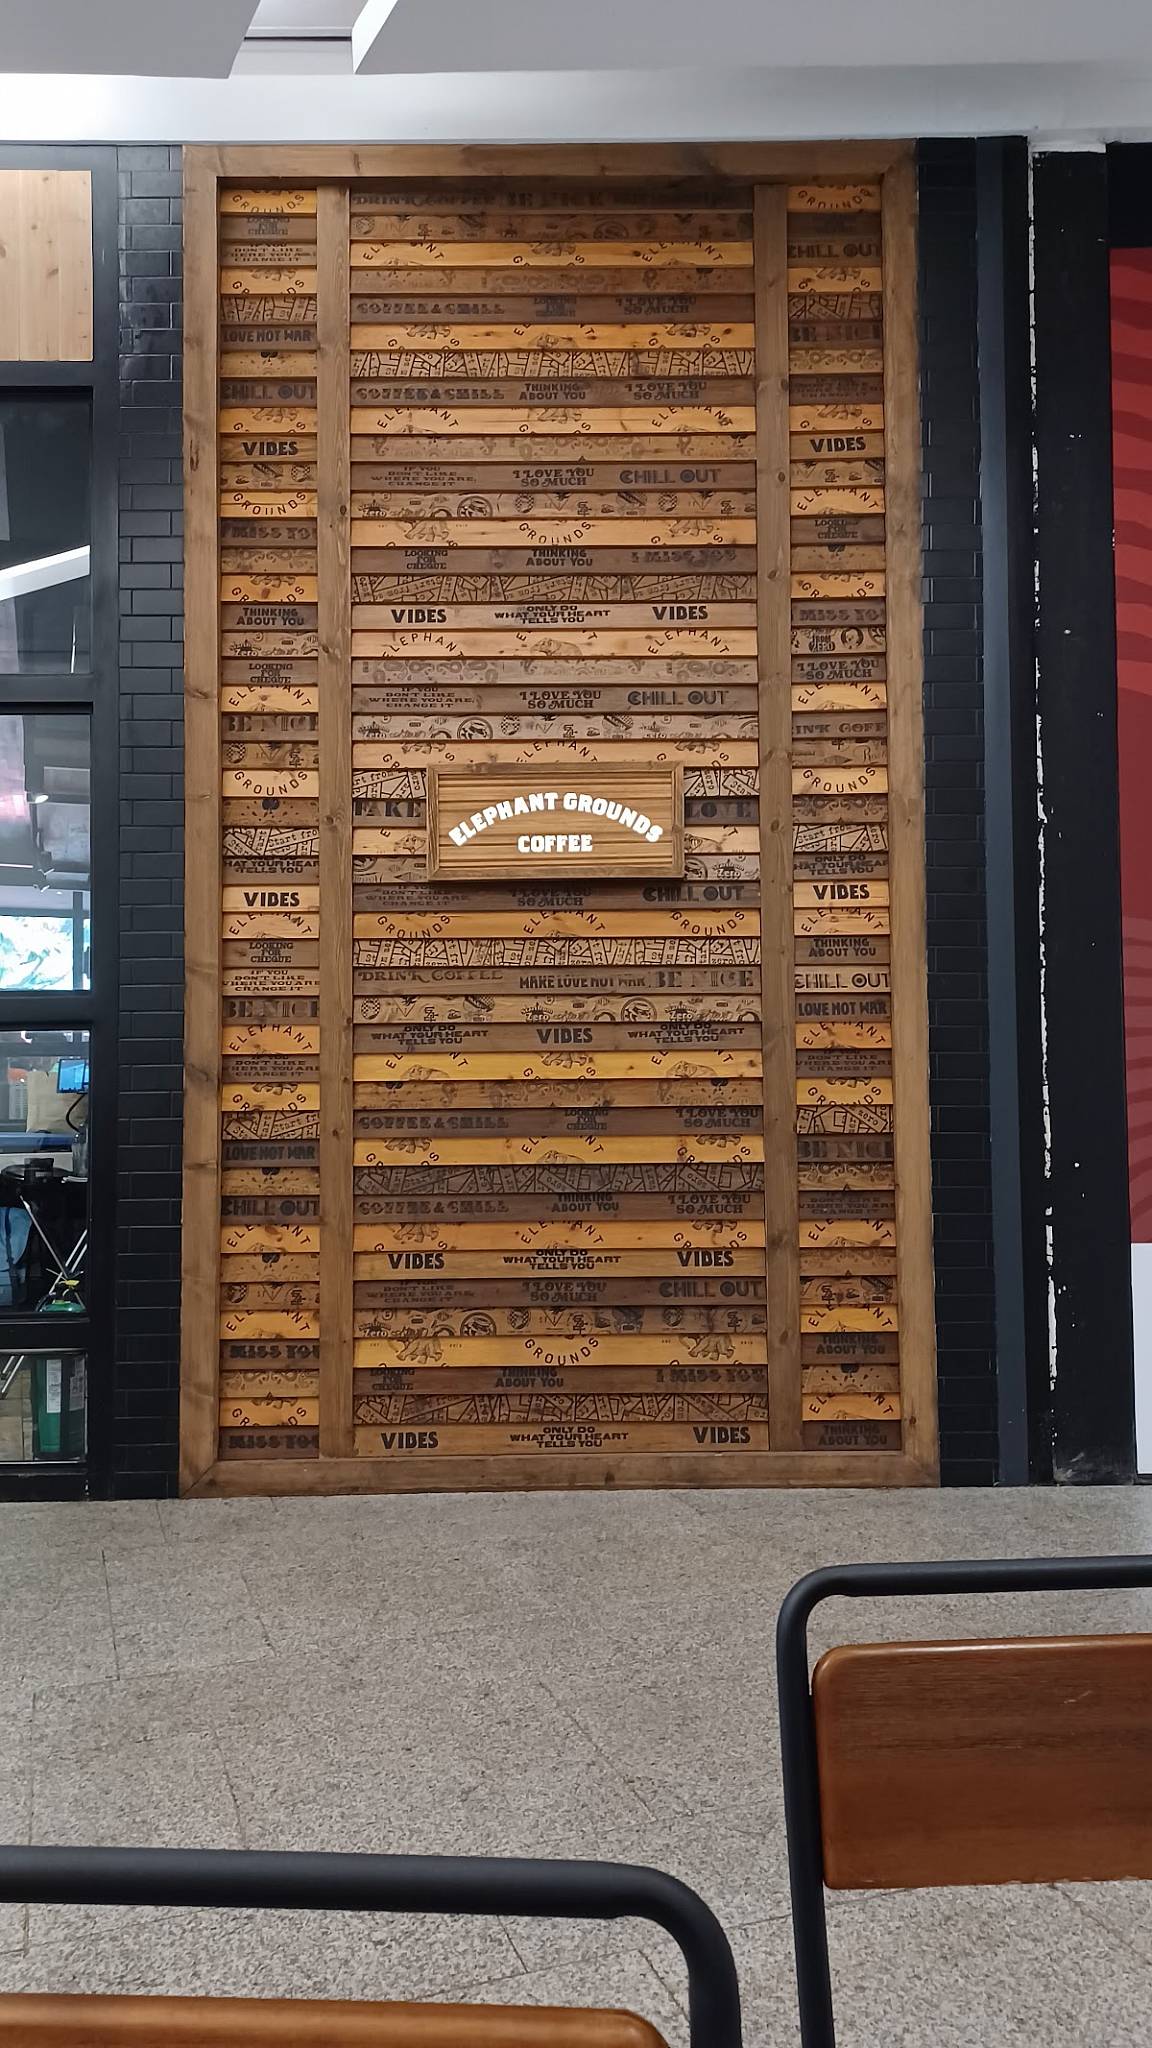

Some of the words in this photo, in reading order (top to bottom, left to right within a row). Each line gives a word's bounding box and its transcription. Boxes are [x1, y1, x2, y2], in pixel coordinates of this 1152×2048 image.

[525, 383, 581, 392] THINKING
[636, 382, 675, 391] LOVE
[678, 380, 707, 390] YOU
[519, 391, 558, 400] ABOUT
[564, 392, 586, 400] YOU
[634, 392, 651, 400] SO
[655, 391, 700, 400] MUCH
[242, 442, 299, 456] VIBES
[810, 437, 866, 452] VIBES
[523, 469, 564, 479] LOVE
[567, 468, 594, 477] YOU
[619, 470, 675, 484] CHILL
[680, 468, 721, 483] OUT
[521, 479, 539, 488] SO
[541, 477, 587, 487] MUCH
[233, 492, 306, 515] GROUNDS
[519, 521, 592, 545] GROUNDS
[532, 549, 587, 558] THINKING
[525, 558, 568, 567] ABOUT
[571, 557, 593, 567] YOU
[243, 608, 298, 616] THINKING
[391, 609, 447, 623] VIBES
[651, 606, 709, 620] VIBES
[237, 617, 279, 626] ABOUT
[282, 617, 304, 626] YOU
[807, 661, 848, 671] LOVE
[851, 658, 879, 669] YOU
[807, 671, 825, 680] SO
[827, 669, 872, 680] MUCH
[530, 691, 569, 700] LOVE
[572, 690, 601, 699] YOU
[628, 691, 684, 705] CHILL
[687, 690, 729, 704] OUT
[528, 701, 546, 709] SO
[548, 699, 593, 709] MUCH
[234, 772, 308, 796] GROUNDS
[803, 767, 876, 793] GROUNDS
[448, 792, 558, 847] ELEPHANT
[563, 793, 664, 844] GROUNDS
[517, 835, 593, 853] COFFEE
[809, 868, 848, 876] TELLS
[642, 888, 700, 901] CHILL
[703, 886, 745, 900] OUT
[813, 884, 870, 900] VIBES
[244, 892, 300, 907] VIBES
[518, 898, 536, 907] SO
[538, 897, 583, 906] MUCH
[377, 915, 451, 938] GROUNDS
[671, 911, 745, 936] GROUNDS
[813, 939, 869, 948] THINKING
[809, 948, 848, 958] ABOUT
[852, 948, 876, 957] YOU
[795, 974, 848, 988] CHILL
[852, 973, 889, 987] OUT
[537, 1028, 593, 1044] VIBES
[686, 1109, 726, 1118] LOVE
[729, 1108, 759, 1118] YOU
[684, 1119, 704, 1128] SO
[705, 1118, 751, 1128] MUCH
[679, 1195, 718, 1204] LOVE
[722, 1194, 751, 1204] YOU
[551, 1203, 591, 1212] ABOUT
[597, 1202, 619, 1211] YOU
[676, 1205, 694, 1214] SO
[697, 1204, 743, 1215] MUCH
[388, 1253, 445, 1269] VIBES
[677, 1251, 734, 1267] VIBES
[572, 1262, 595, 1270] YOU
[533, 1282, 573, 1291] LOVE
[576, 1281, 607, 1291] YOU
[659, 1282, 716, 1297] CHILL
[720, 1281, 763, 1297] OUT
[530, 1292, 549, 1301] SO
[551, 1292, 598, 1302] MUCH
[525, 1337, 599, 1366] GROUNDS
[816, 1344, 858, 1354] ABOUT
[863, 1344, 885, 1354] YOU
[495, 1378, 535, 1387] ABOUT
[540, 1377, 564, 1387] YOU
[381, 1432, 439, 1449] VIBES
[693, 1426, 751, 1444] VIBES
[579, 1440, 602, 1448] YOU
